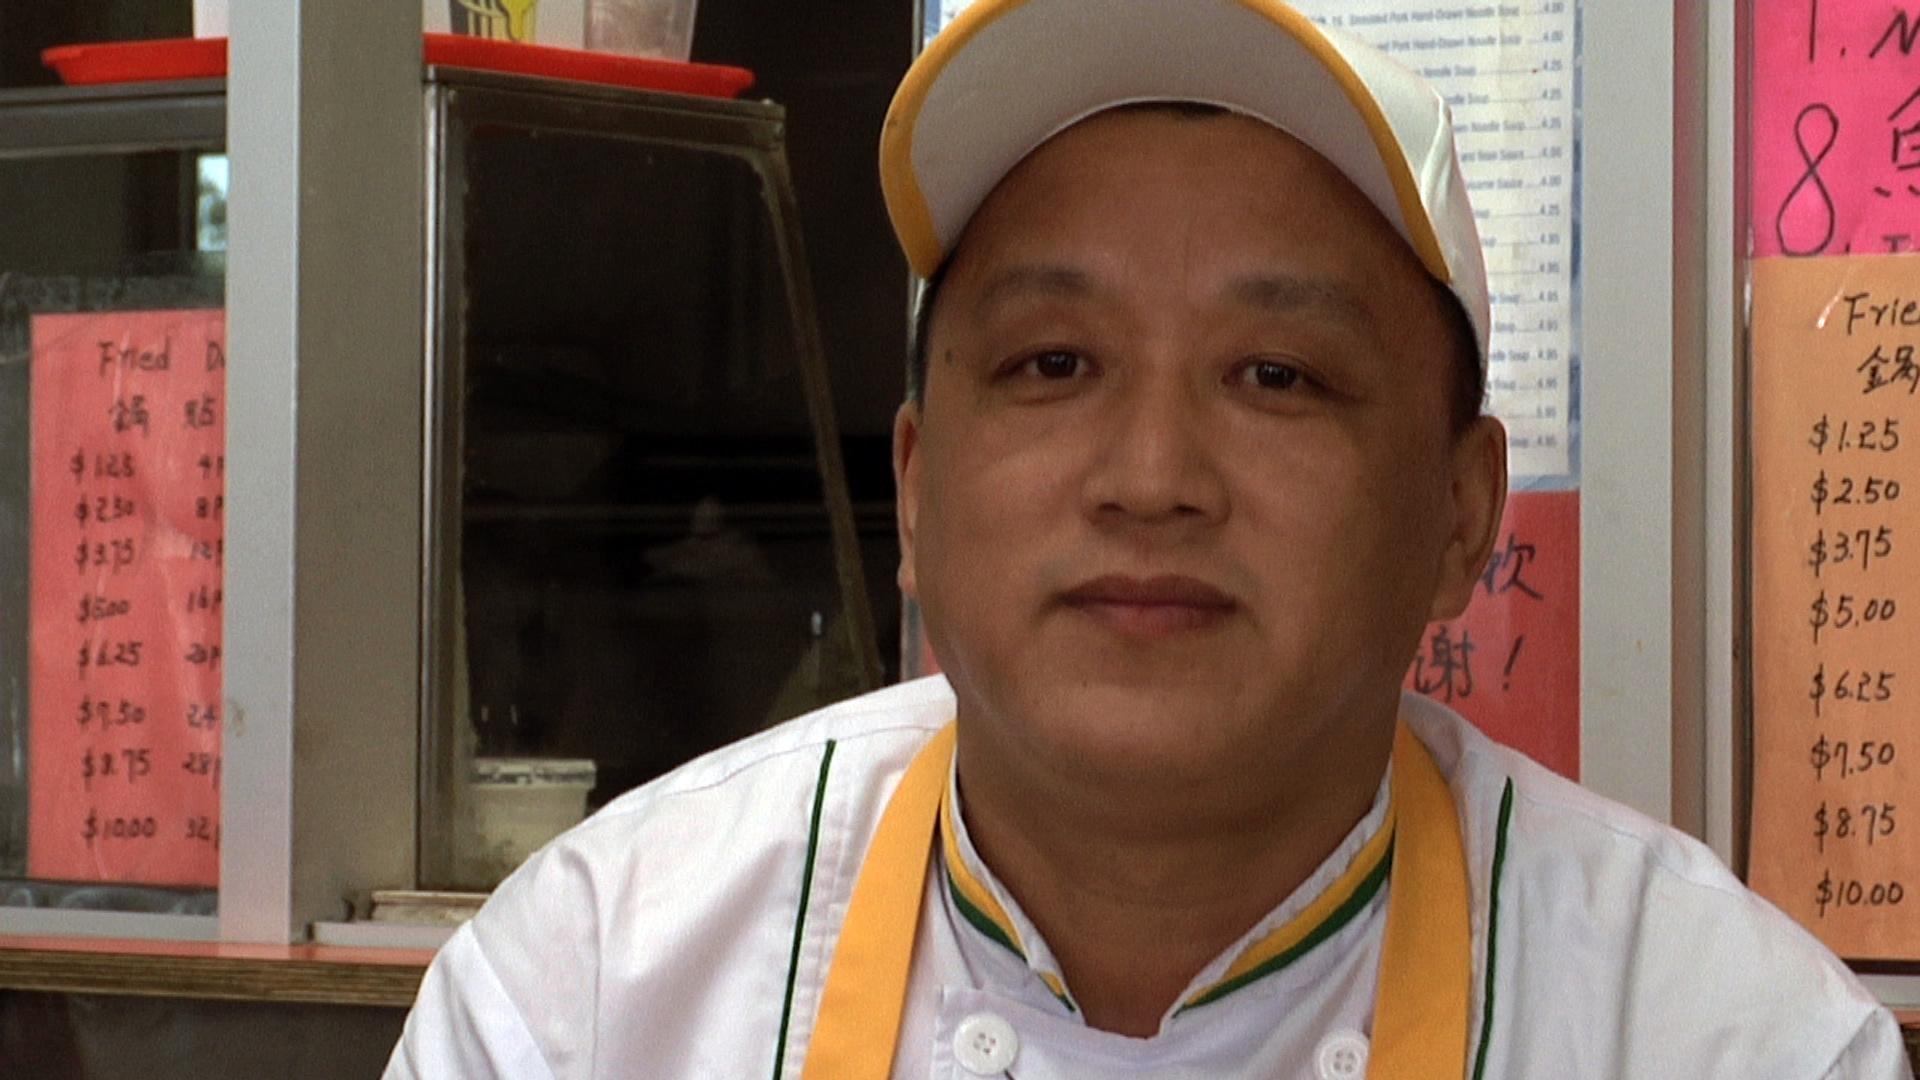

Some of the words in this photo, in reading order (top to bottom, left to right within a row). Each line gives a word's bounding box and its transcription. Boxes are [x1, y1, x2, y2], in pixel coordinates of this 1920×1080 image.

[97, 335, 169, 376] Fried
[1808, 414, 1900, 455] $1.25
[1809, 470, 1900, 515] $2.50
[1808, 529, 1893, 577] $3.75
[1809, 589, 1897, 644] $5.00
[1808, 663, 1896, 718] $6.25
[1810, 734, 1896, 782] $7.50
[1812, 802, 1897, 854] $8.75
[1814, 869, 1904, 919] $10.00
